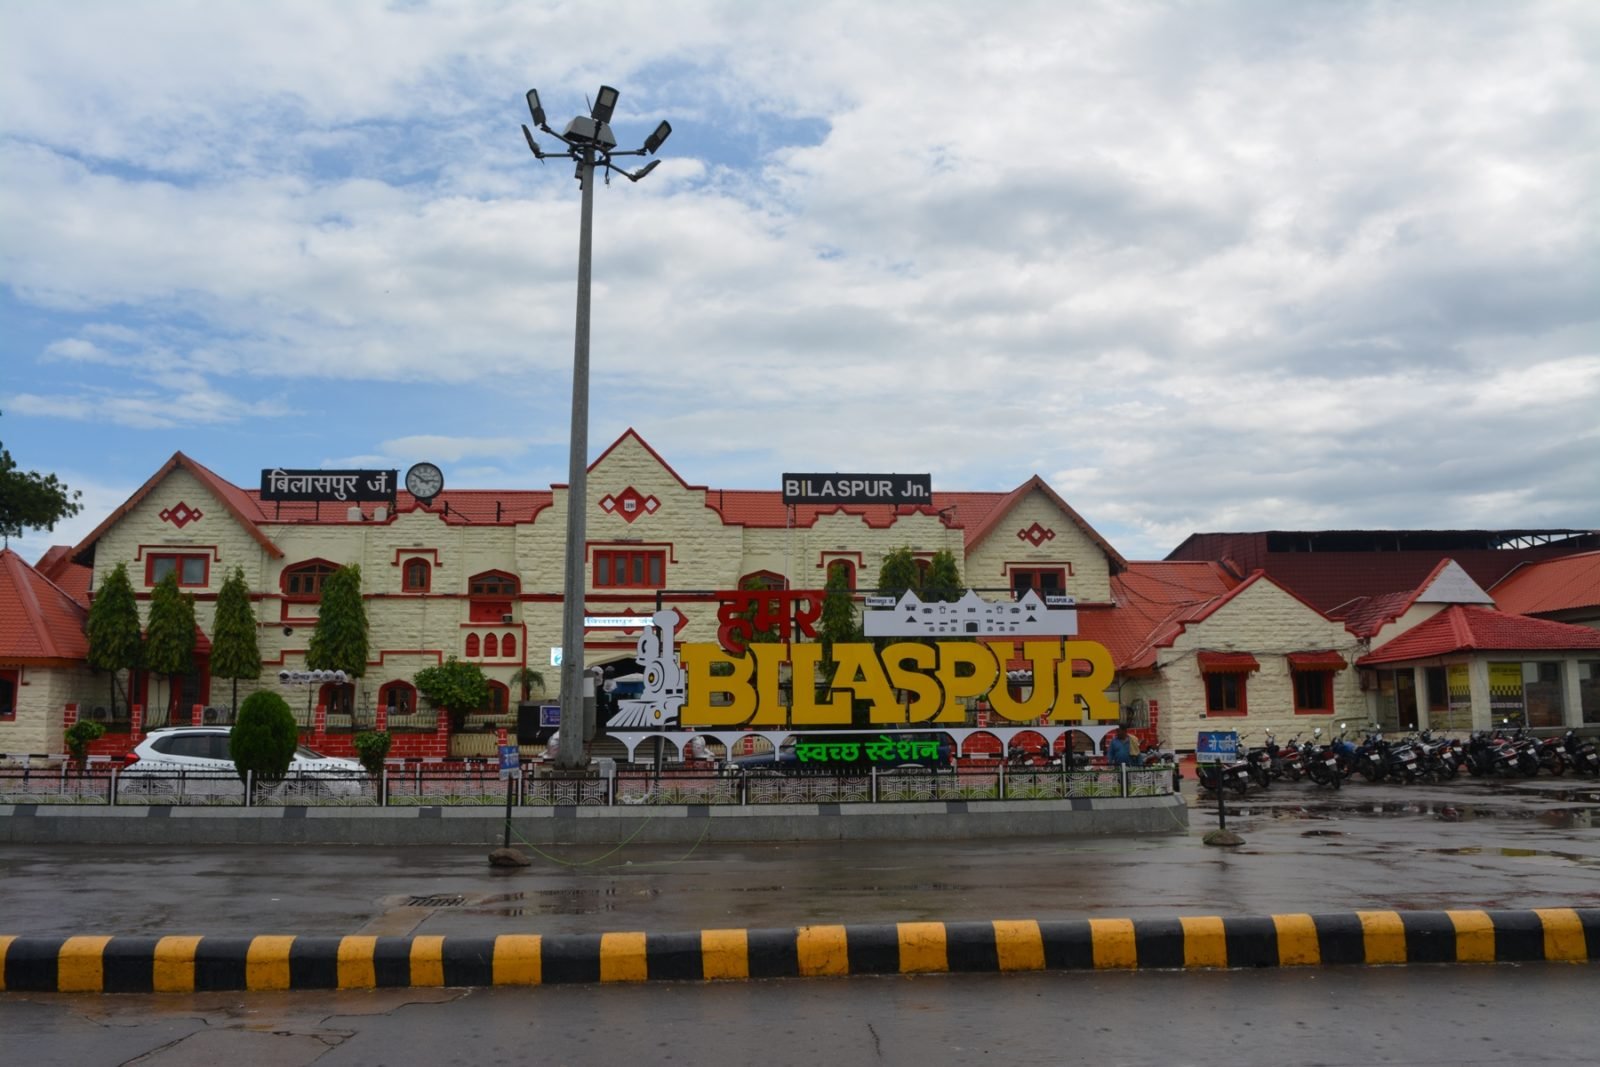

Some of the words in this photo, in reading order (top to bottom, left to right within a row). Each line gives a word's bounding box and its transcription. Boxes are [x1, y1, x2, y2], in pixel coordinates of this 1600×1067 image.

[268, 470, 359, 500] बिलासपुर
[367, 472, 391, 494] जं.
[785, 480, 893, 497] BILASPUR
[901, 480, 929, 497] Jn.
[716, 590, 827, 653] हमर
[680, 640, 1120, 725] BILASPUR
[795, 743, 860, 761] स्वच्छ
[865, 735, 940, 760] स्टेशन
